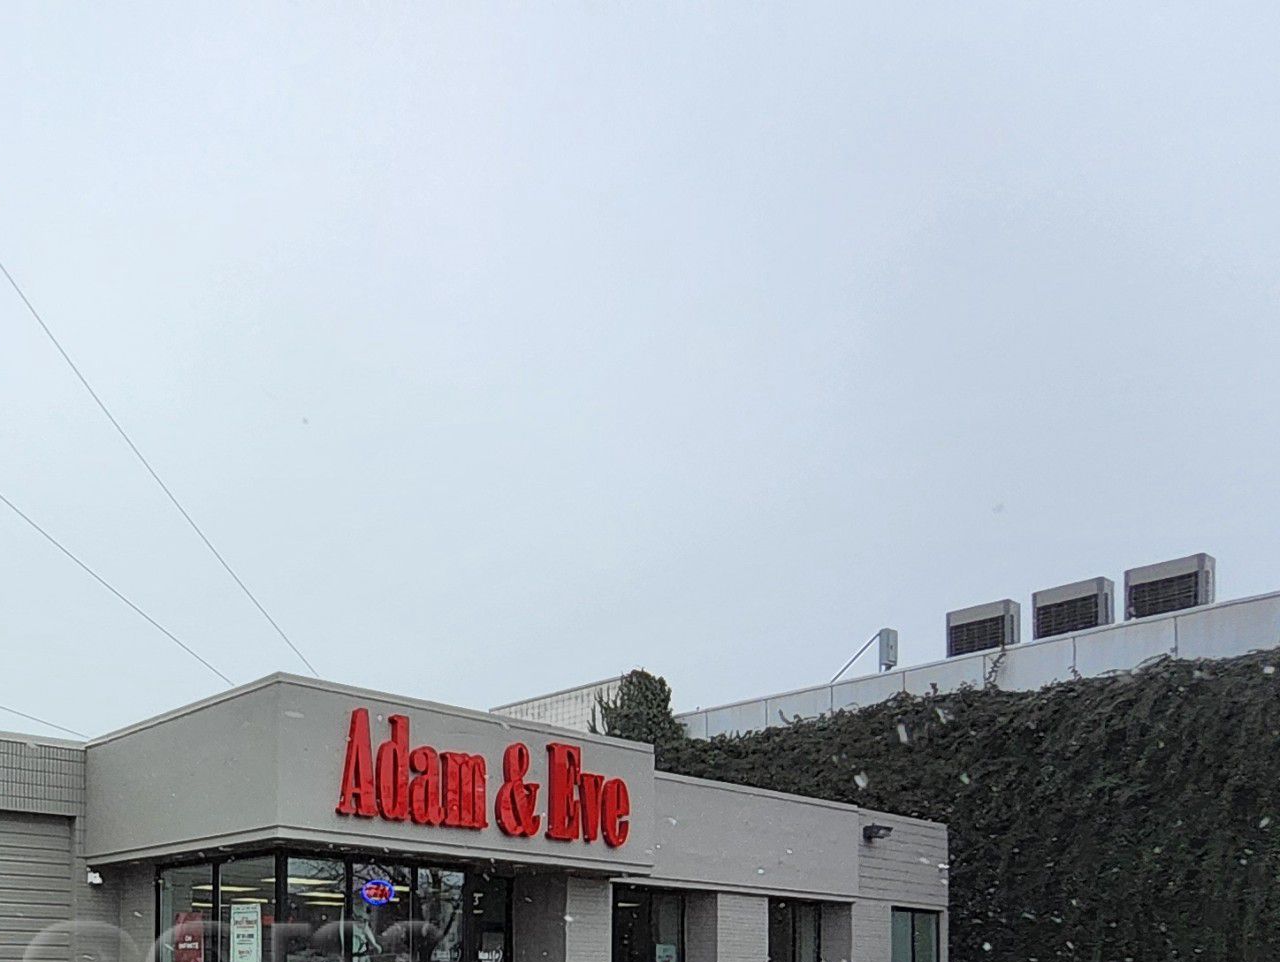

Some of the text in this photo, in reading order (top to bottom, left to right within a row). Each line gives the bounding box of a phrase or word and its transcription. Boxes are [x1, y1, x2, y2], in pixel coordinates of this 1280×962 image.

[335, 707, 631, 848] Adam & Eve
